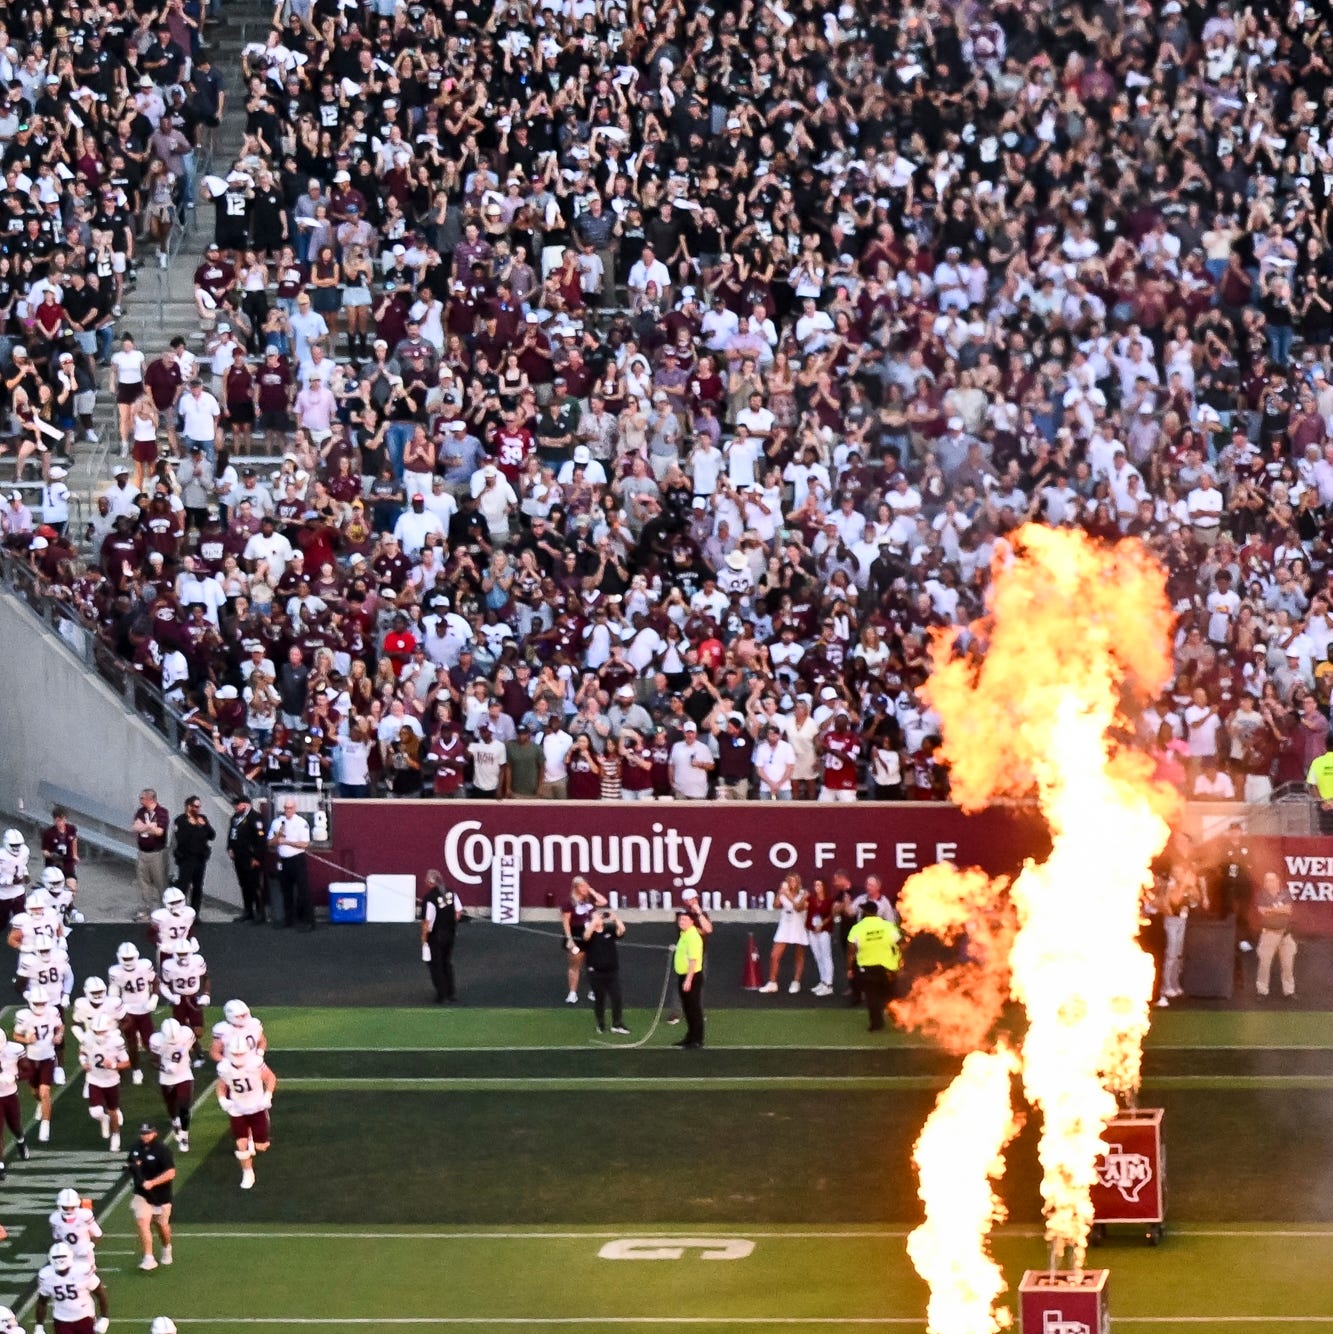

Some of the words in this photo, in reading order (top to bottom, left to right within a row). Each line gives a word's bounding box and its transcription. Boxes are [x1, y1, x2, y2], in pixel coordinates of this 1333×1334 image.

[444, 820, 714, 886] Community
[729, 842, 958, 869] COFFEE
[498, 854, 517, 925] WHITE
[38, 967, 59, 985] 58
[94, 1053, 106, 1069] 2
[232, 1076, 254, 1094] 51
[53, 1284, 78, 1302] 55
